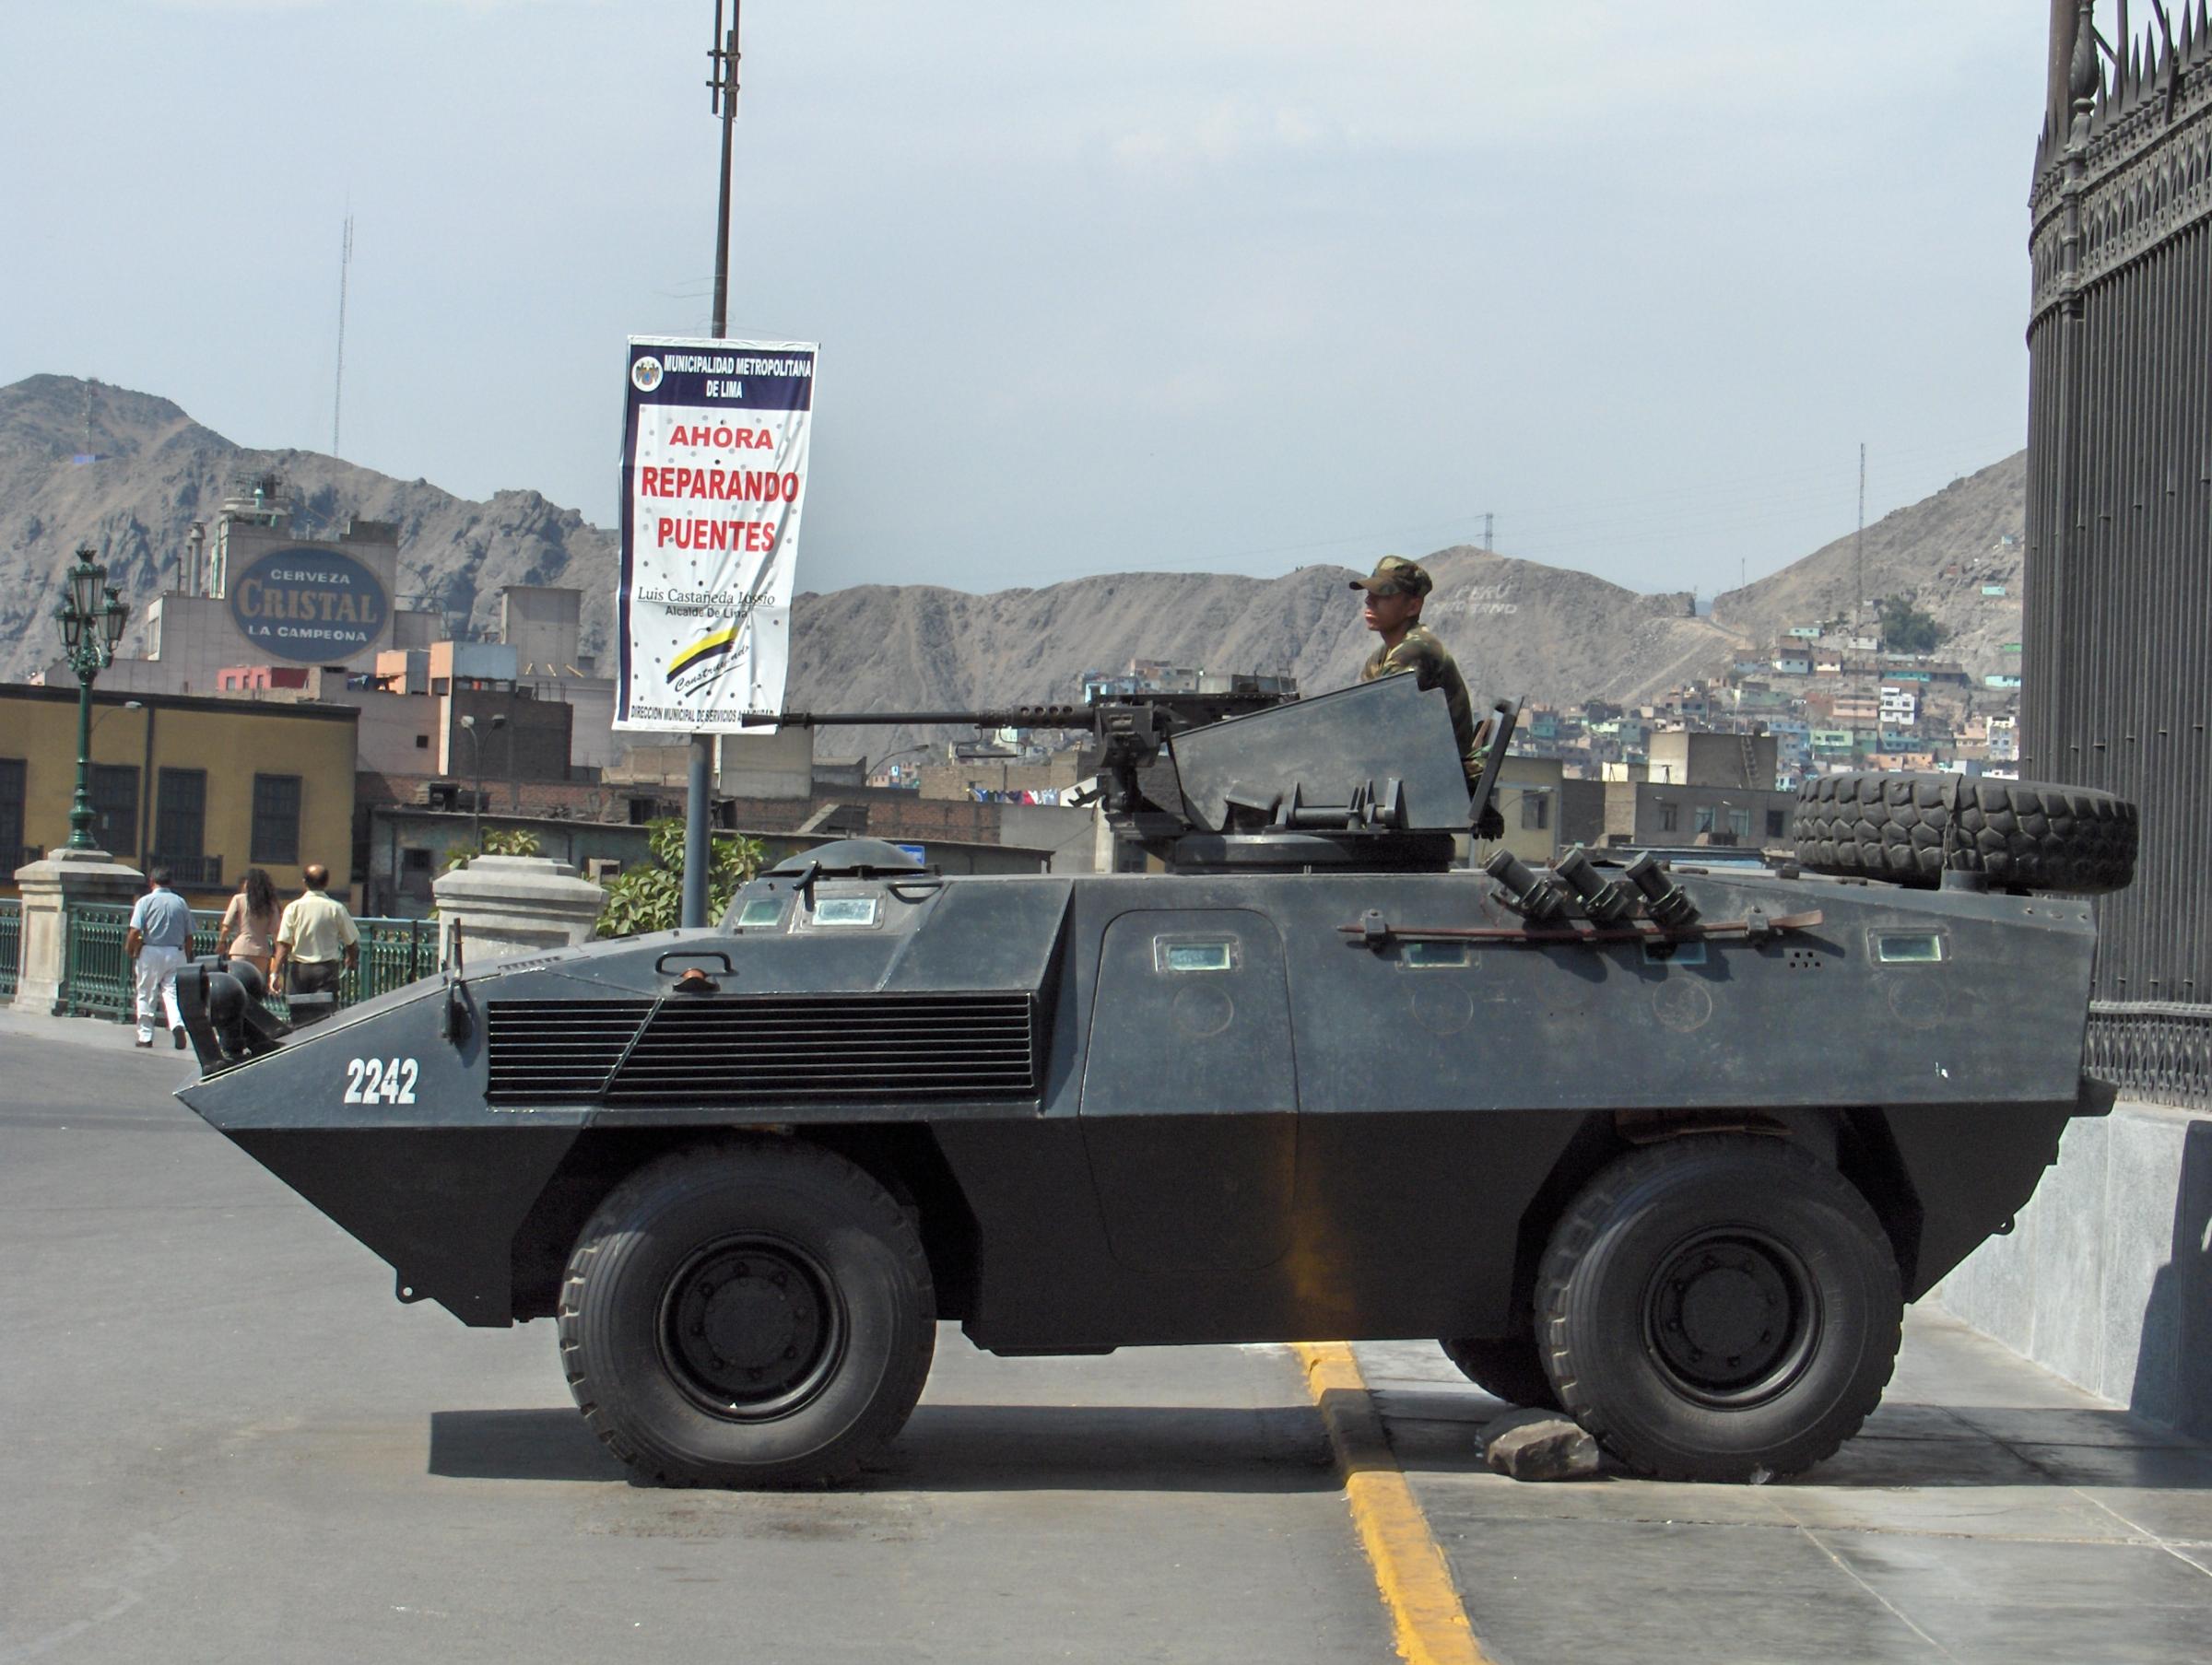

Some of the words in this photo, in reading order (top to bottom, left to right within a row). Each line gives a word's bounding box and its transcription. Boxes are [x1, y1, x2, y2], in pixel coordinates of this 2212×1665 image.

[664, 354, 735, 374] MUNICIPALIDAD
[735, 358, 812, 377] METROPOLITANA
[706, 380, 719, 397] DE
[721, 381, 743, 398] LIMA
[669, 426, 774, 450] AHORA
[641, 466, 799, 503] REPARANDO
[658, 518, 775, 552] PUENTES
[270, 569, 351, 584] CERVEZA
[237, 578, 378, 623] CRISTAL
[638, 586, 664, 601] Luis
[667, 588, 734, 604] Castañeda
[665, 605, 704, 617] Alcalde
[707, 607, 721, 618] De
[248, 626, 271, 636] LA
[277, 627, 367, 642] CAMPEONA
[664, 708, 695, 721] MUNICIPAL
[704, 709, 736, 722] SERVICIOS
[344, 1058, 418, 1104] 2242
